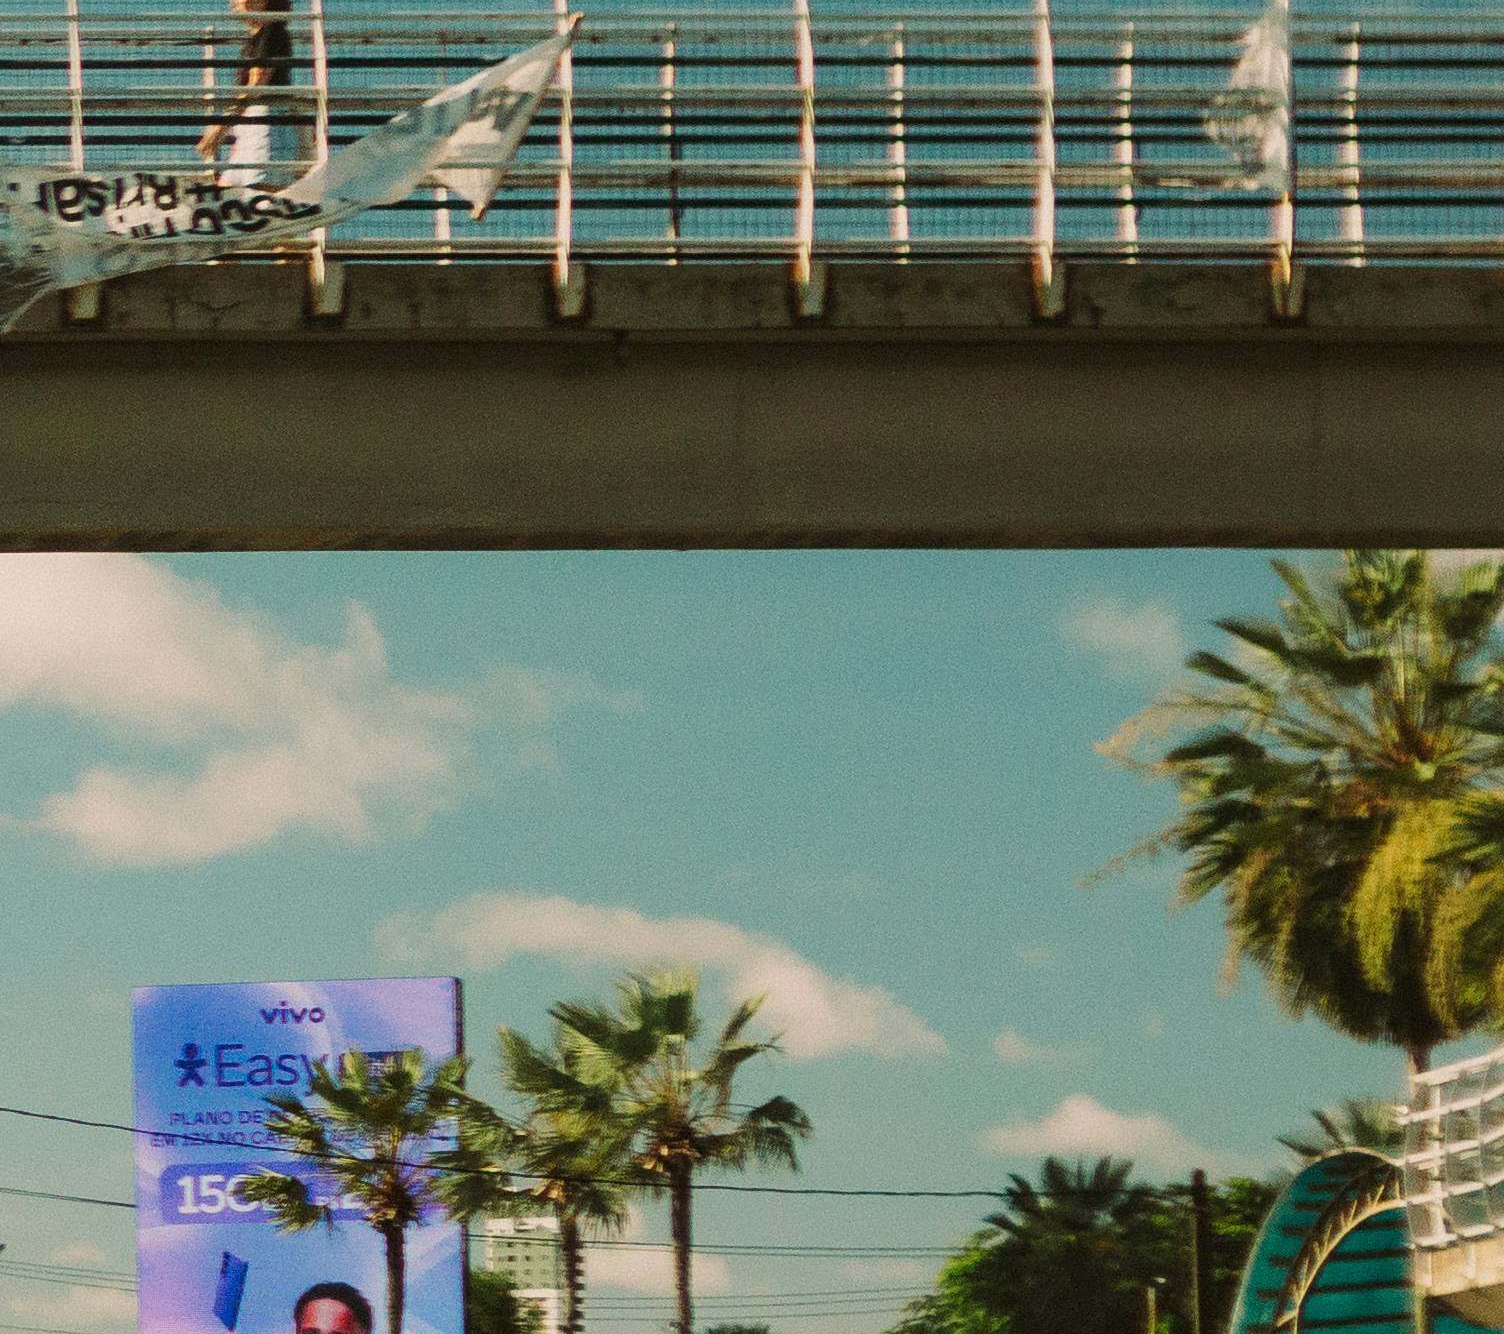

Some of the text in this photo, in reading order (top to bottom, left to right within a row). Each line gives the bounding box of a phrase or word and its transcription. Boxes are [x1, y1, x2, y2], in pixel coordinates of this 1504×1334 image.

[261, 1001, 325, 1025] vivo
[215, 1043, 329, 1096] Easy
[170, 1109, 264, 1127] PLANO DE
